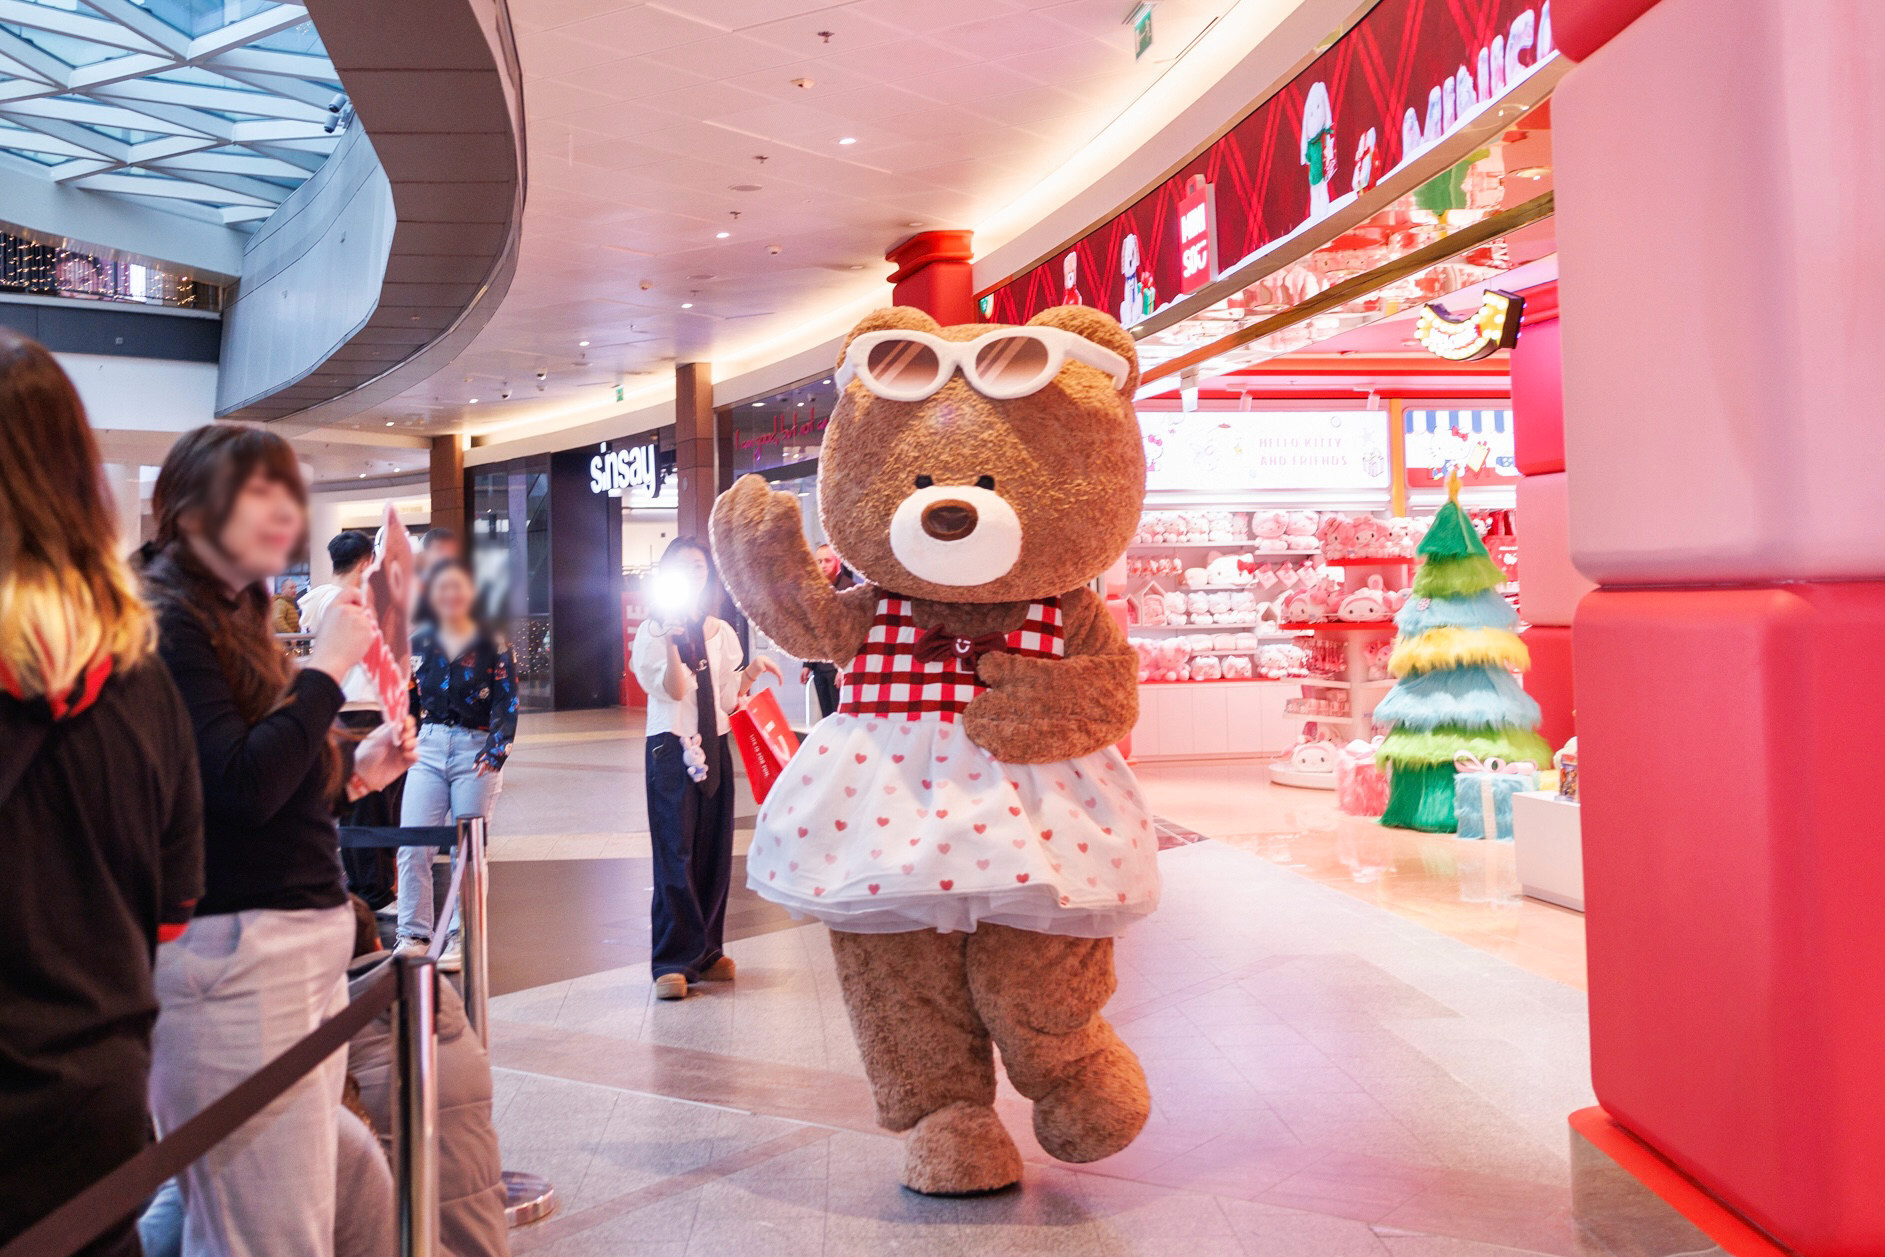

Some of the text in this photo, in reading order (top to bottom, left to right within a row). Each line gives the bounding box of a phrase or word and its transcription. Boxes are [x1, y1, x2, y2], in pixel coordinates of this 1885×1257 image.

[1181, 202, 1206, 244] MINI
[1259, 438, 1342, 448] HELLO KITTY
[590, 441, 656, 498] sinsay
[1260, 455, 1348, 466] AND FRIENDS
